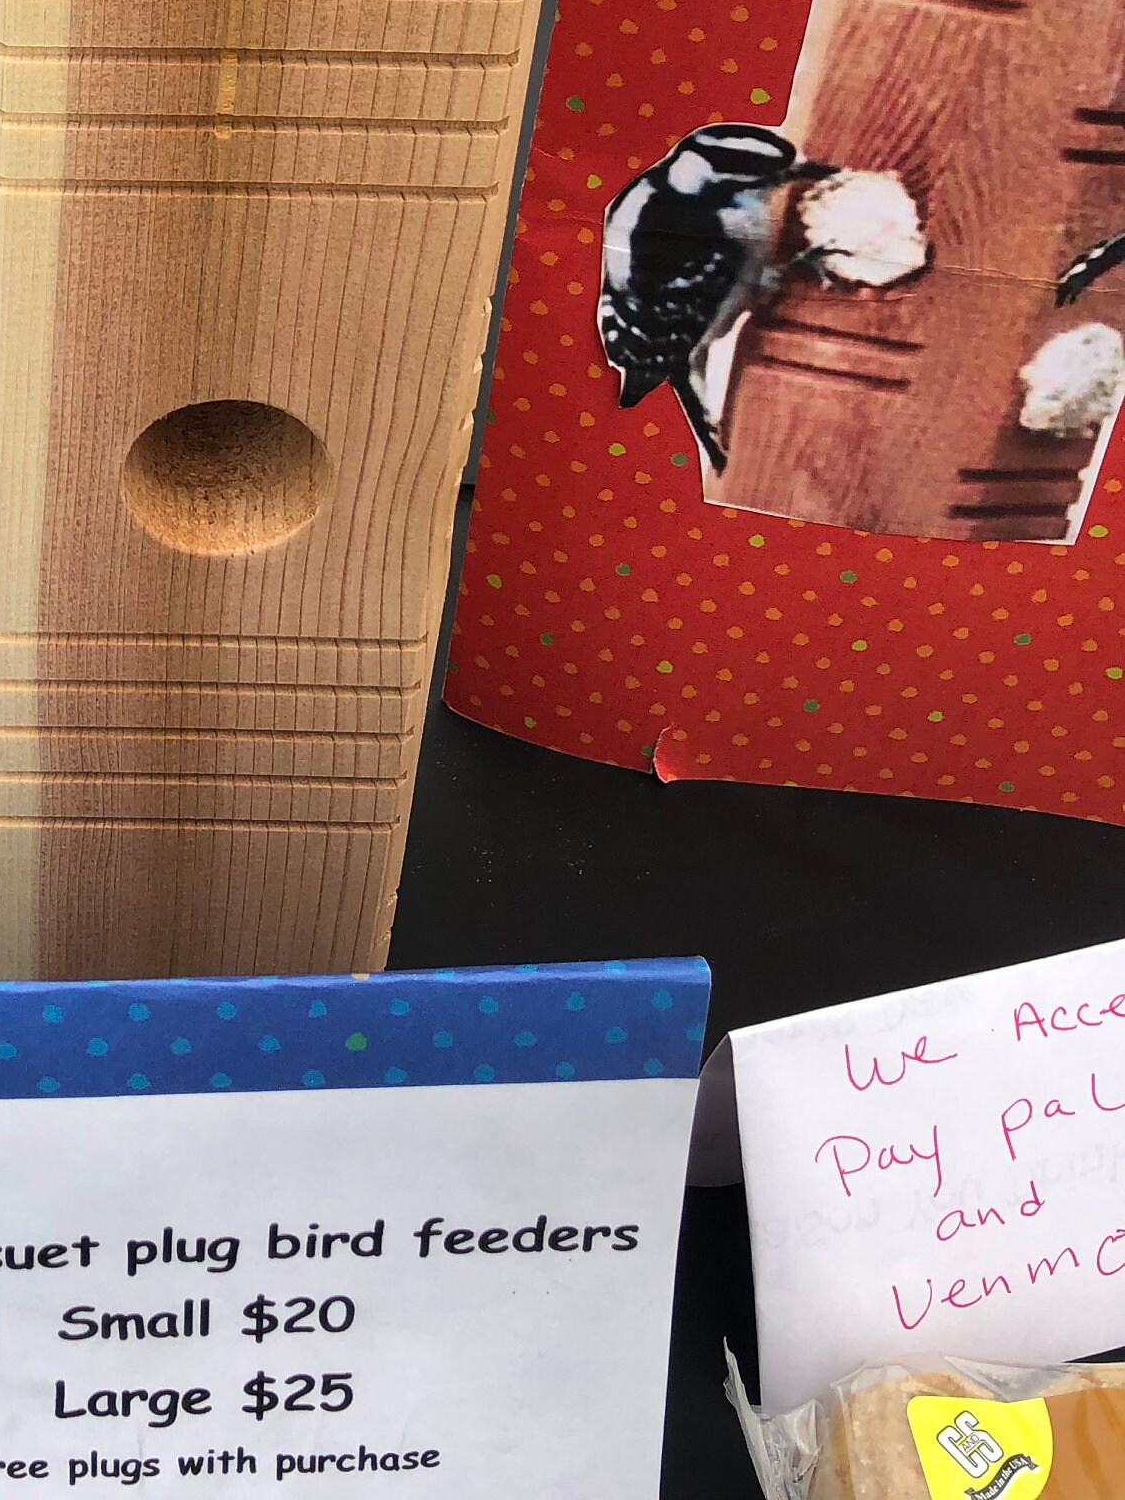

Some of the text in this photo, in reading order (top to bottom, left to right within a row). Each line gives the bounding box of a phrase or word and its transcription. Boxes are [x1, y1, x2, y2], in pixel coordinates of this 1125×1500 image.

[845, 1036, 956, 1091] We
[815, 1126, 941, 1197] Pay
[935, 1180, 1044, 1241] and
[126, 1226, 240, 1277] plug
[267, 1219, 385, 1260] bird
[414, 1214, 640, 1258] feeders
[57, 1294, 356, 1344] Small $20
[54, 1370, 354, 1428] Large $25
[68, 1450, 160, 1486] plugs
[177, 1446, 257, 1477] with
[276, 1445, 440, 1481] purchase
[974, 1457, 1029, 1500] Made in the USA
